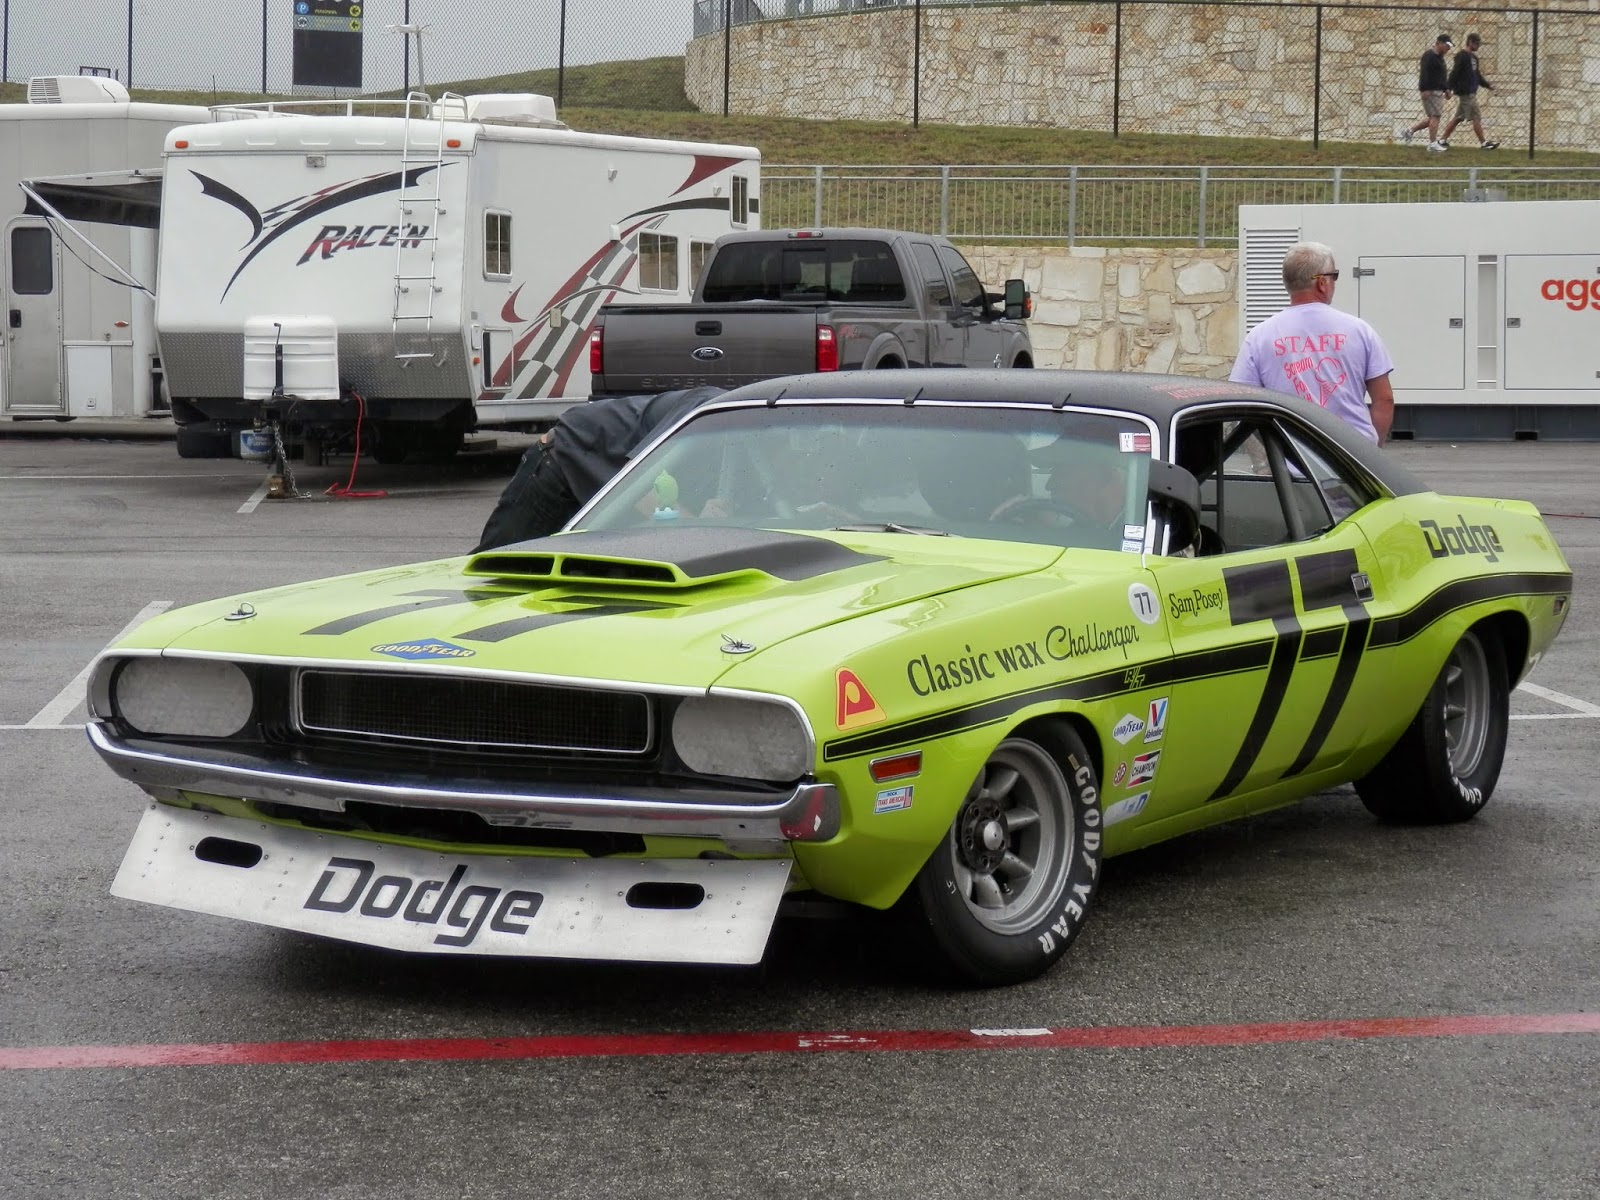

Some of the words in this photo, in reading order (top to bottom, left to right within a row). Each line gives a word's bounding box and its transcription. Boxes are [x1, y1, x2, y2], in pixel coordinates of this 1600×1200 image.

[1274, 333, 1347, 357] STAFF
[1418, 513, 1505, 563] Dodge
[1133, 591, 1152, 615] 77
[1168, 592, 1198, 620] Sam
[1193, 587, 1224, 611] Posey
[906, 644, 996, 697] Classic
[994, 640, 1046, 674] wax
[1045, 622, 1140, 660] Challenger
[1207, 548, 1371, 801] 77
[1131, 761, 1156, 777] CHAMPION
[303, 856, 545, 948] Dodge
